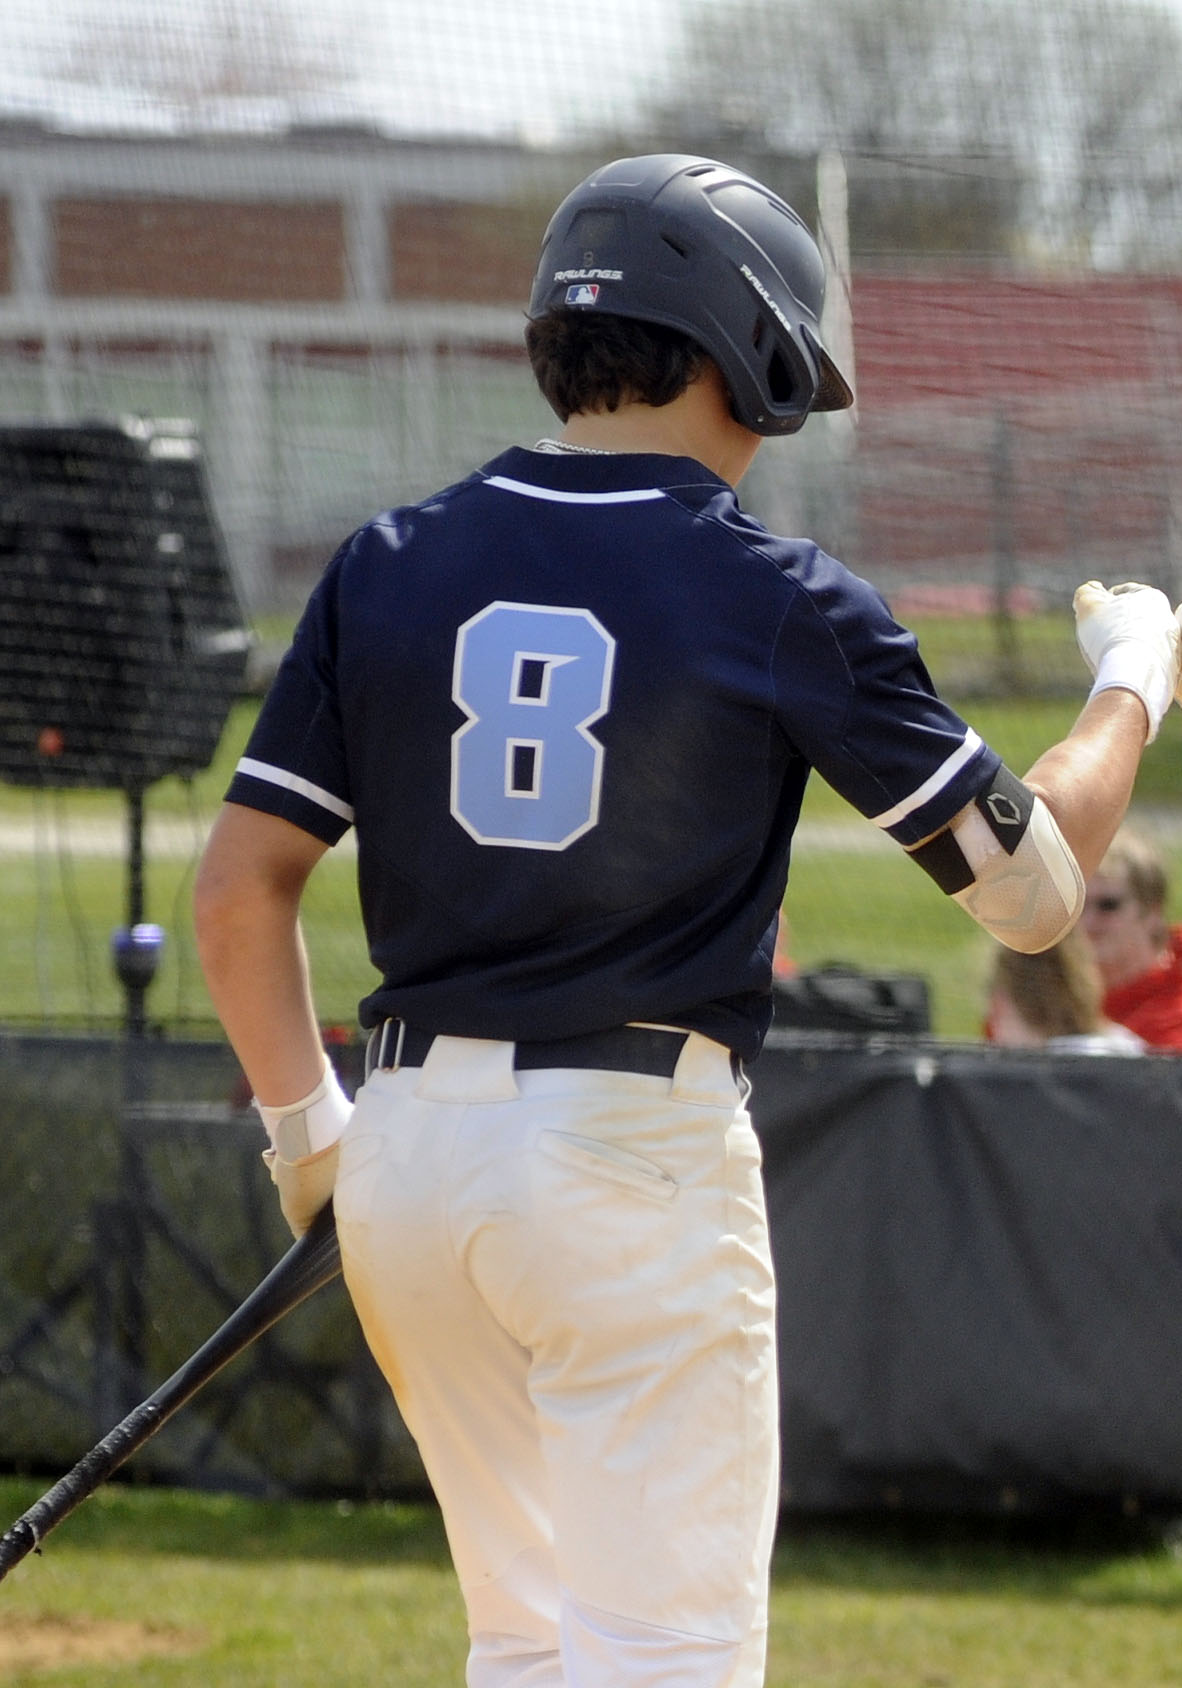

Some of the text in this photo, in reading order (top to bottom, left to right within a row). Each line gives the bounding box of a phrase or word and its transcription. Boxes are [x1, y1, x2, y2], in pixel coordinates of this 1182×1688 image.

[554, 268, 624, 281] RAWLINGS
[740, 263, 792, 331] RAWLINGS
[450, 600, 616, 851] 8
